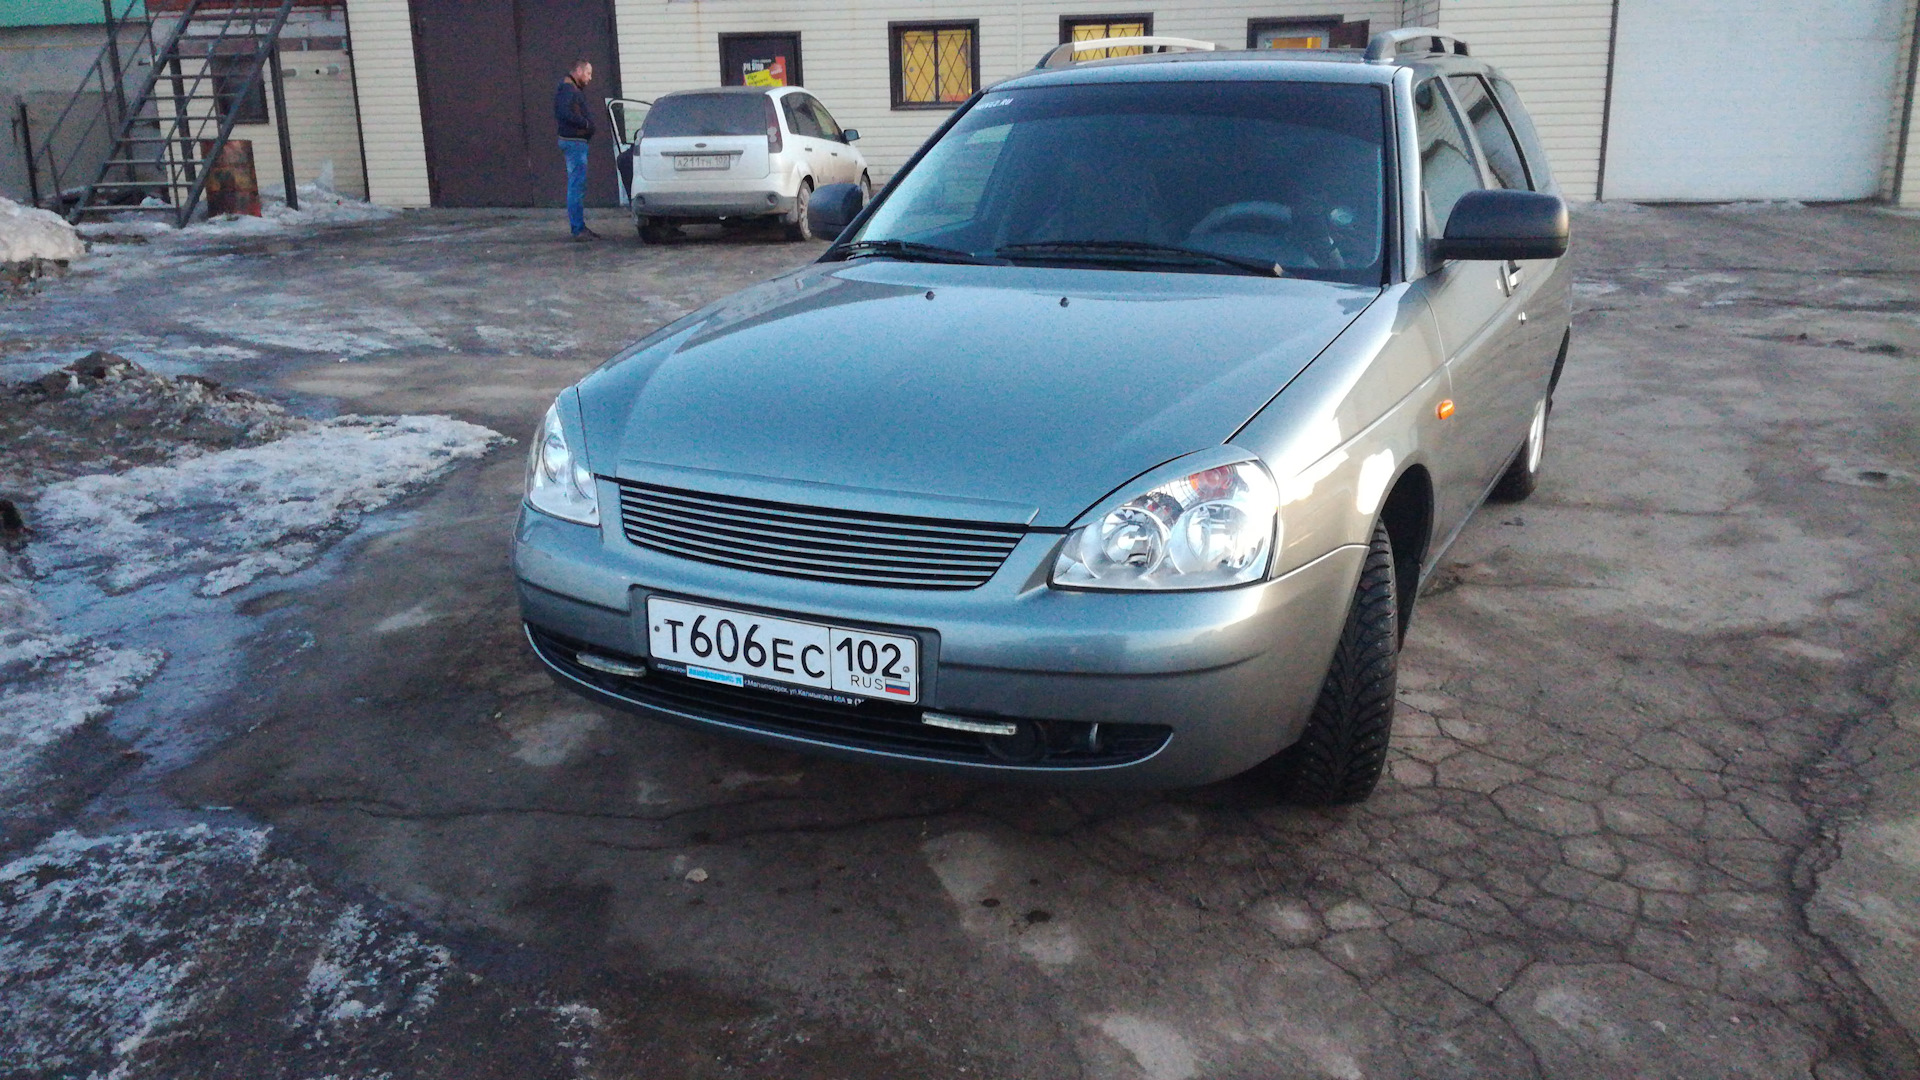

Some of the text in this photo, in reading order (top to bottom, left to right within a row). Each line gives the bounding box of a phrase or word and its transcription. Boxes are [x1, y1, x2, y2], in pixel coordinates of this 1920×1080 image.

[663, 614, 902, 679] Т606ЕС 102
[850, 674, 884, 691] RUS
